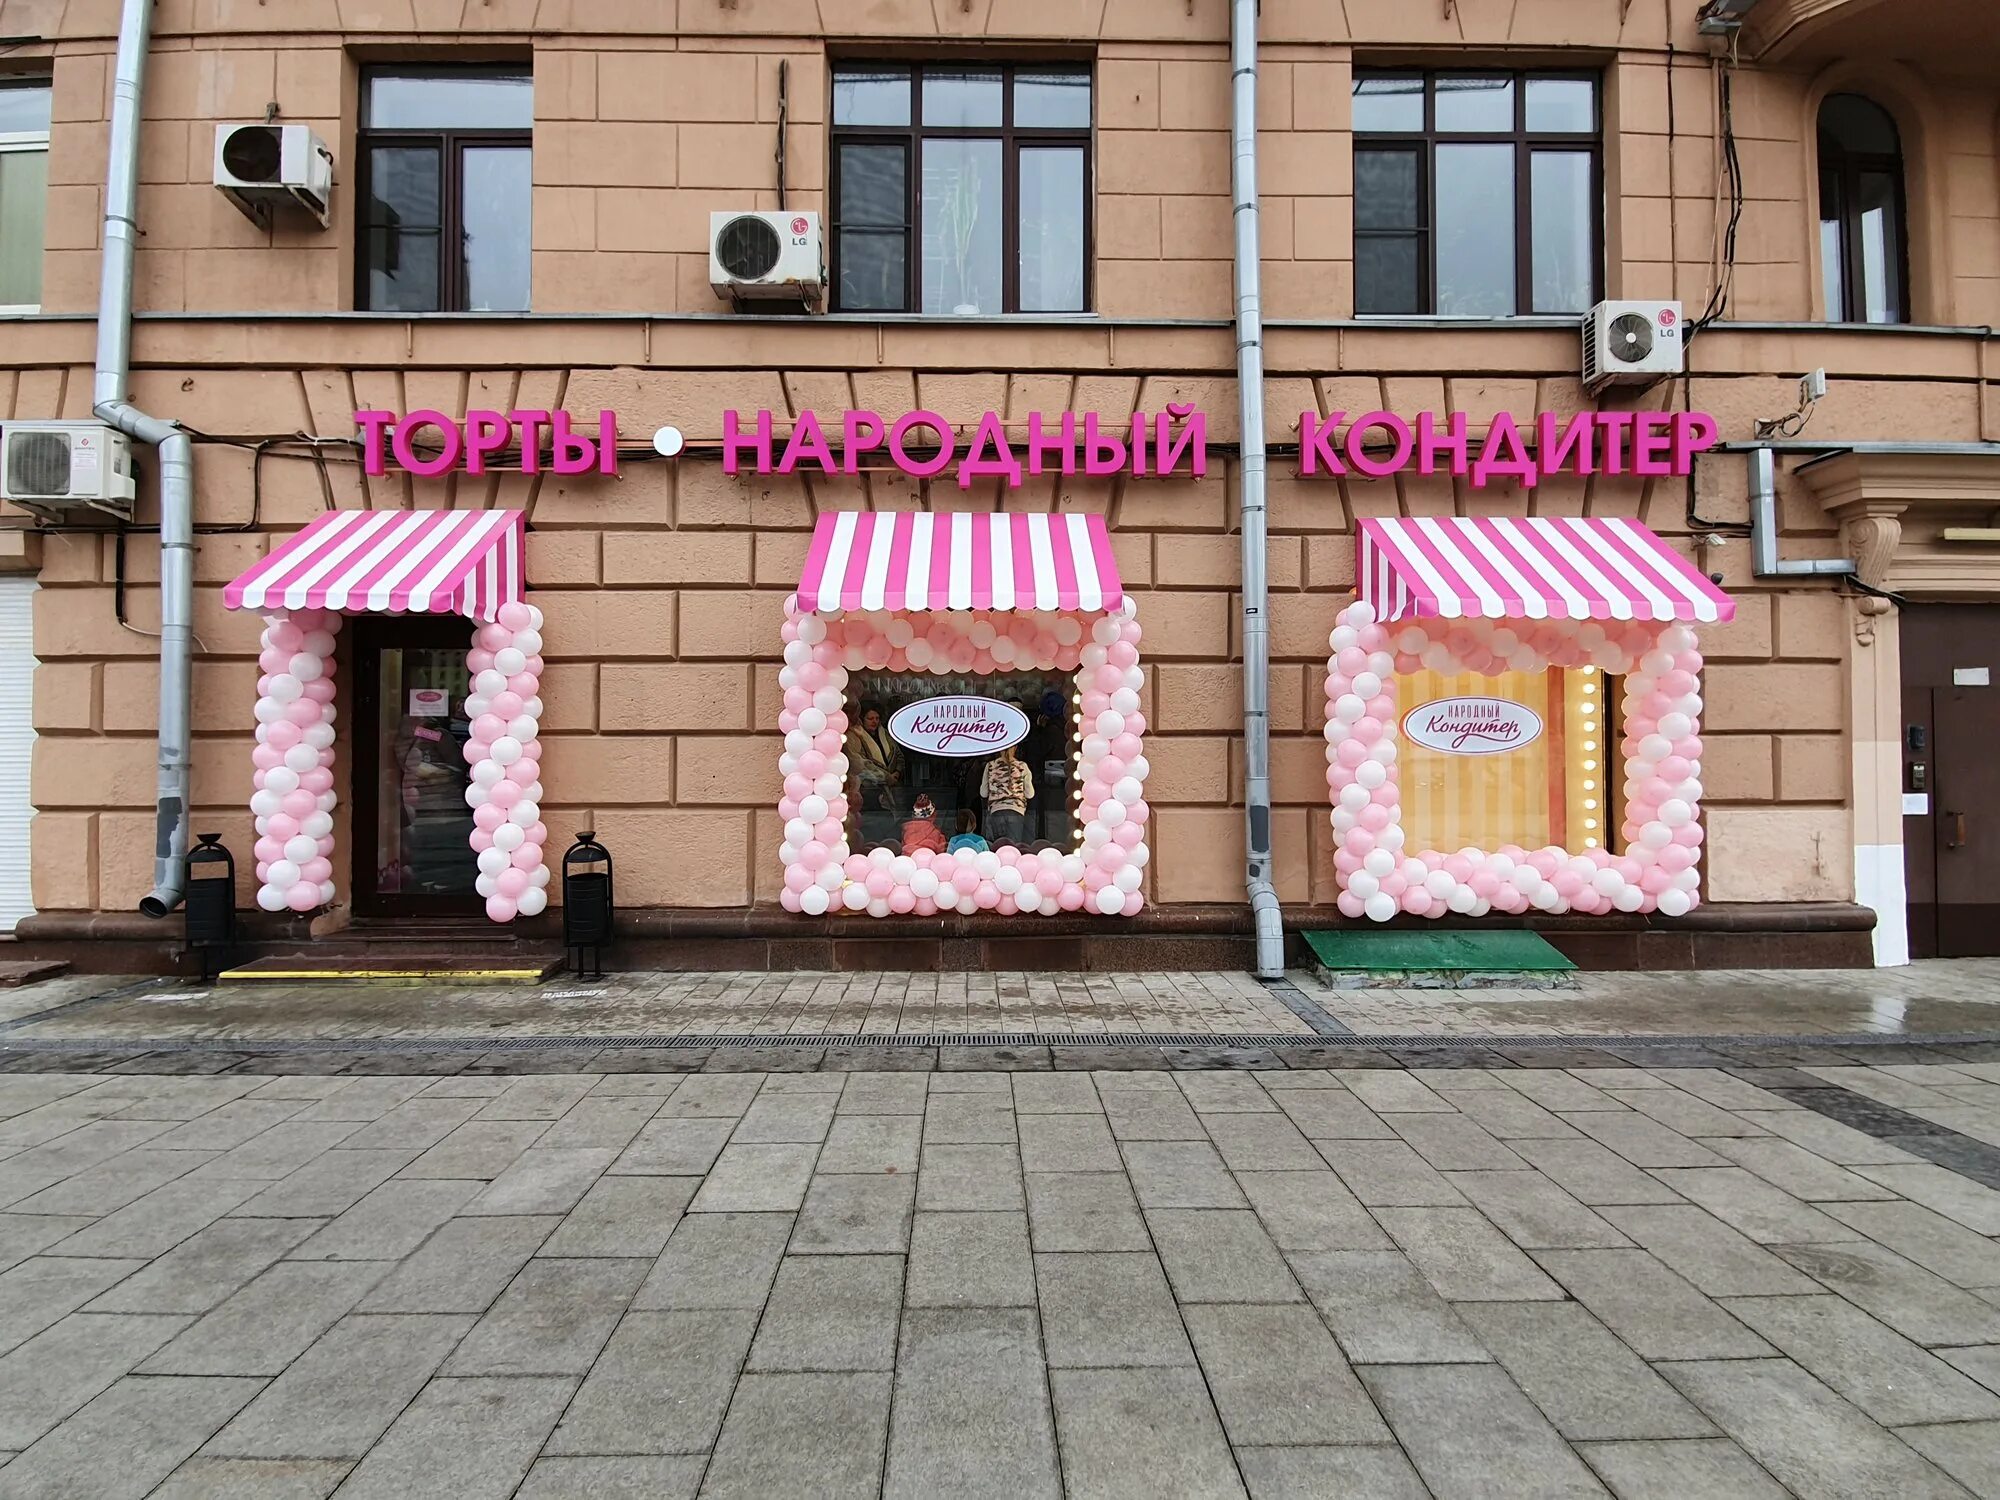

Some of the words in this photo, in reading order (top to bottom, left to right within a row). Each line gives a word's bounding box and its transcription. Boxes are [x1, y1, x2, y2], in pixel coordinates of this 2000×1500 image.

[792, 237, 807, 246] LG
[1660, 329, 1674, 338] LG
[355, 409, 616, 477] ТОРТЫ
[722, 402, 1206, 488] НАРОДНЫЙ
[1299, 410, 1719, 488] КОНДИТЕР
[933, 702, 986, 719] НАРОДНЫЙ
[1448, 702, 1500, 718] НАРОДНЫЙ
[910, 714, 1008, 750] Кондитер
[1425, 714, 1522, 750] Кондитер
